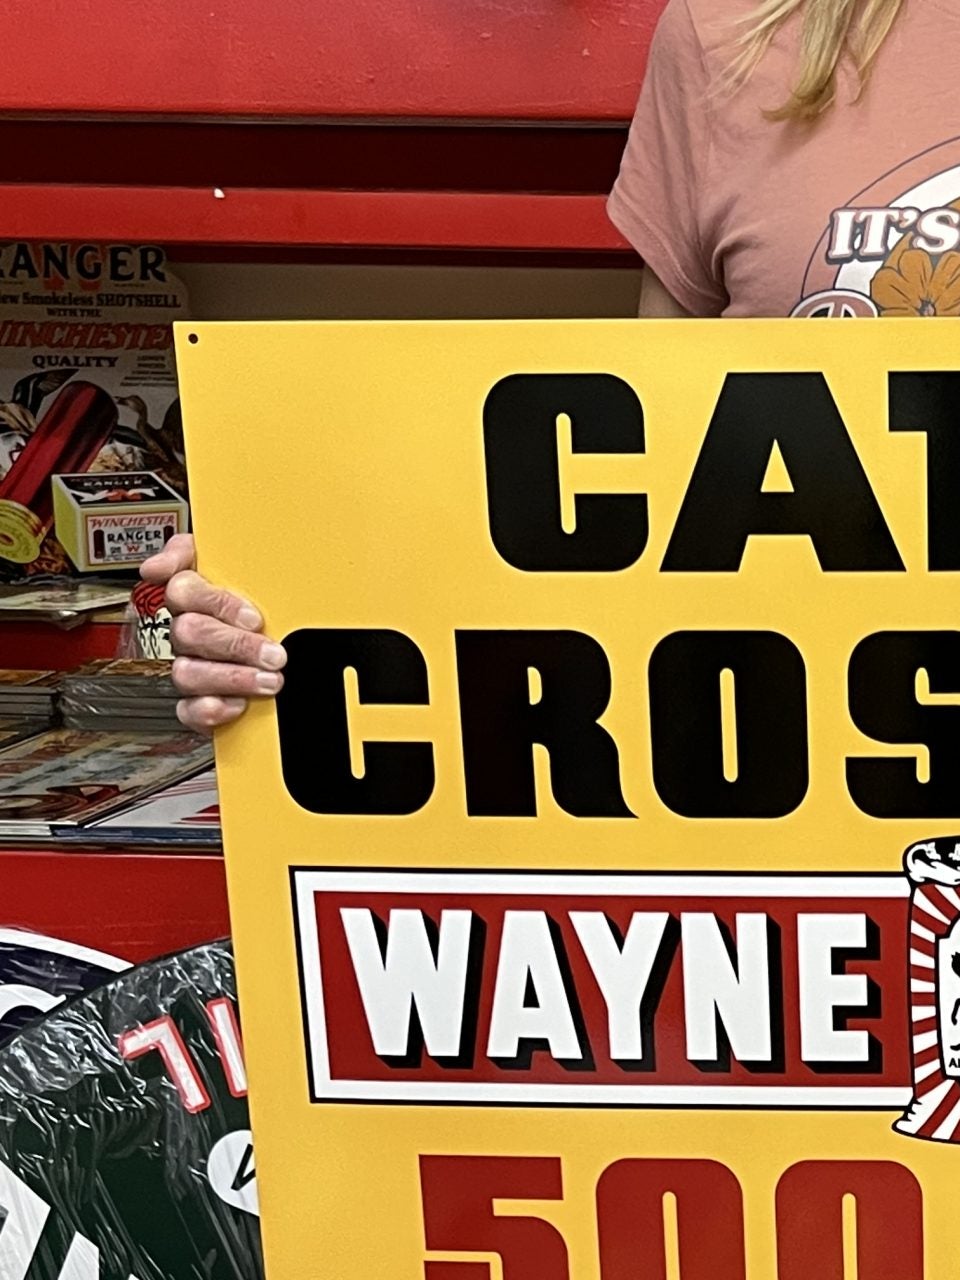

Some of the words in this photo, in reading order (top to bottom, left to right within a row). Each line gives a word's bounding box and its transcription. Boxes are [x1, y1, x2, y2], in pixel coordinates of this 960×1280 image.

[0, 242, 166, 283] ANGER
[33, 355, 118, 368] QUALITY
[90, 516, 175, 528] WINCHESTER
[107, 530, 162, 543] RANGER
[339, 906, 880, 1075] WAYNE
